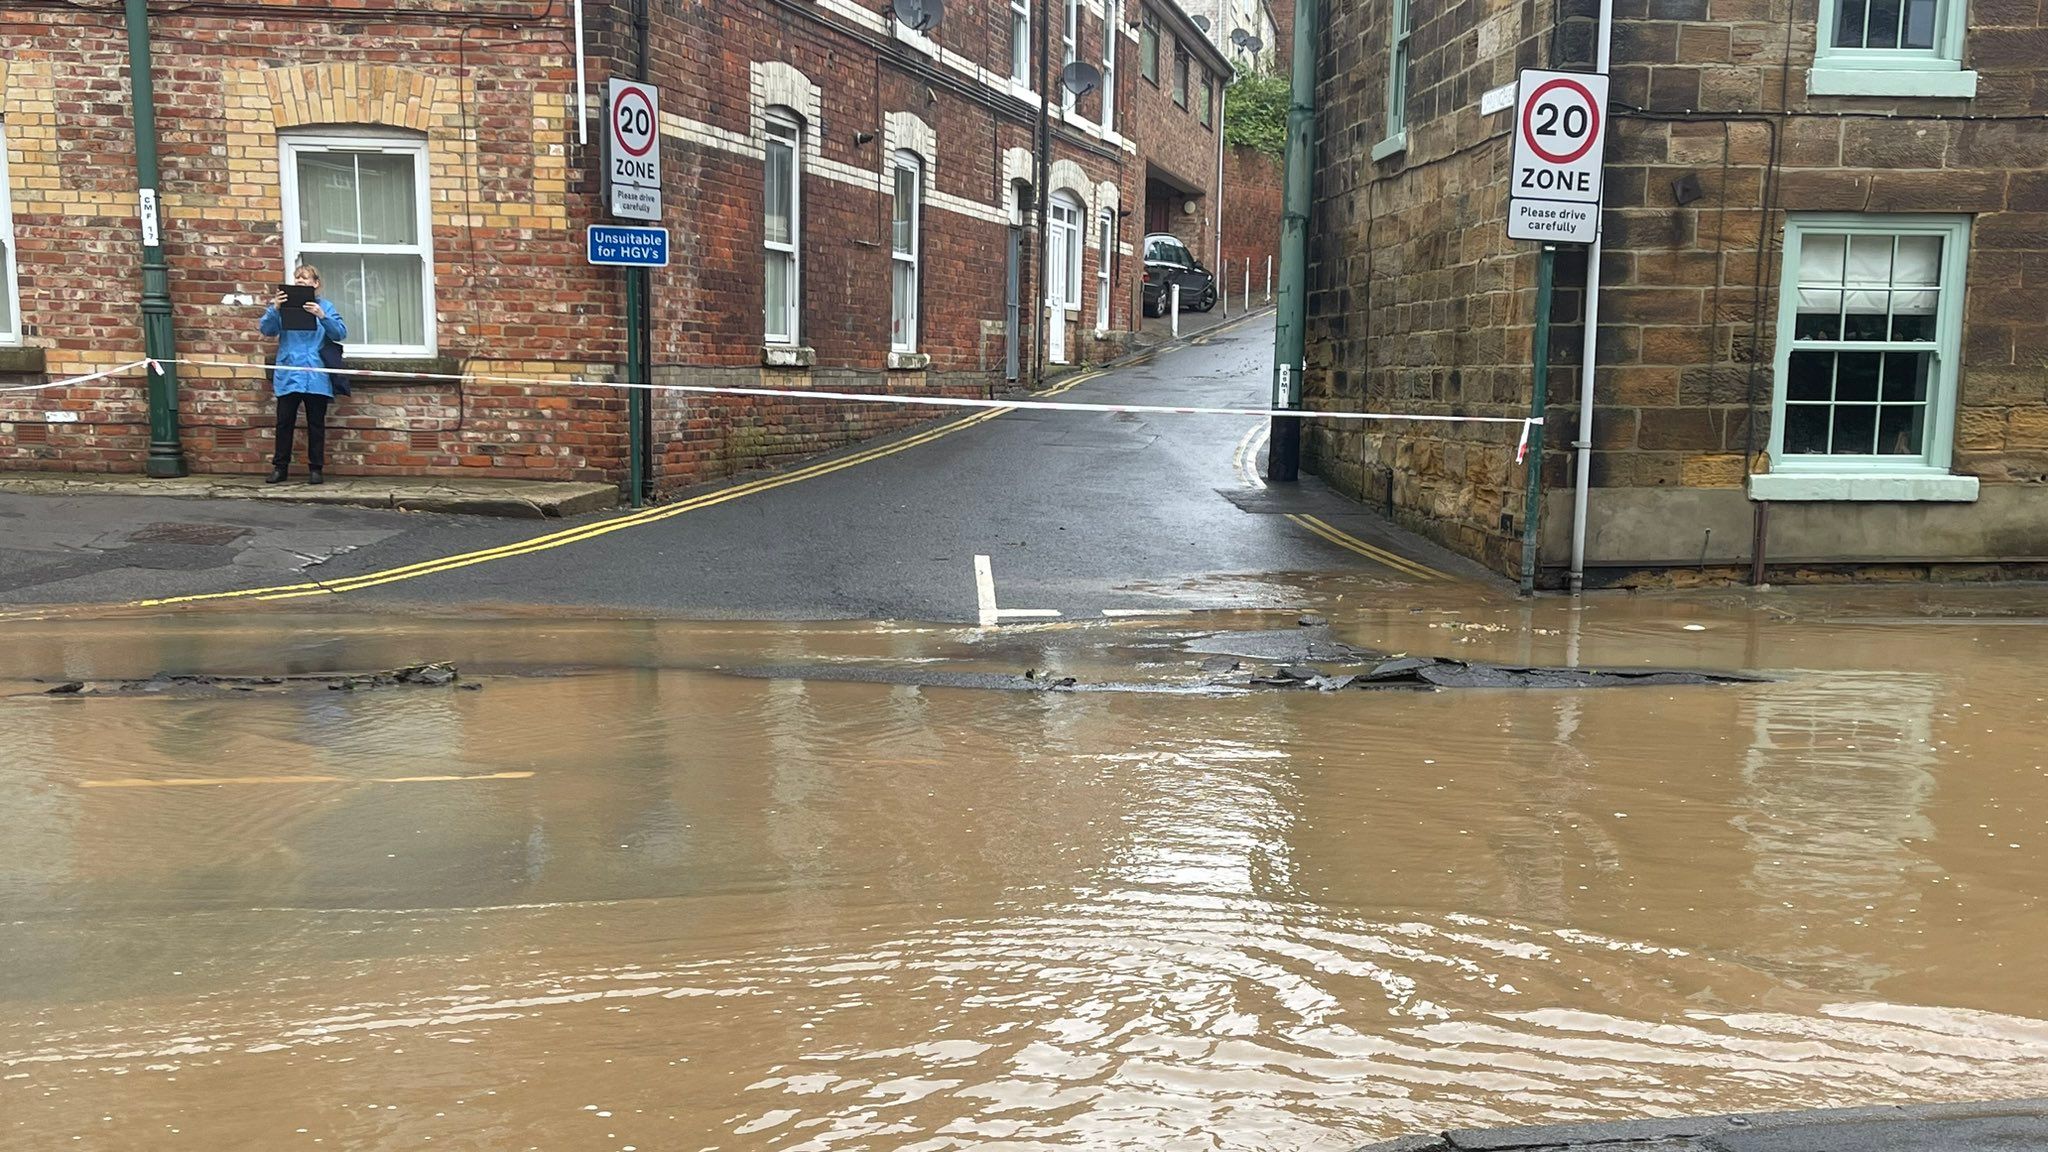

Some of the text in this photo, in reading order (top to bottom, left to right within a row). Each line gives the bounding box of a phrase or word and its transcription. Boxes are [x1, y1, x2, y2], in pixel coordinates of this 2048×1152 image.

[620, 106, 650, 136] 20
[1536, 103, 1588, 138] 20
[616, 158, 655, 180] ZONE
[1521, 168, 1590, 192] ZONE
[617, 190, 655, 203] Please drive
[144, 197, 152, 219] CMF
[622, 203, 650, 213] carefully
[1520, 206, 1586, 220] Please drive
[1528, 221, 1577, 234] carefully
[595, 231, 662, 246] Unsuitable
[598, 245, 659, 259] for HGV's
